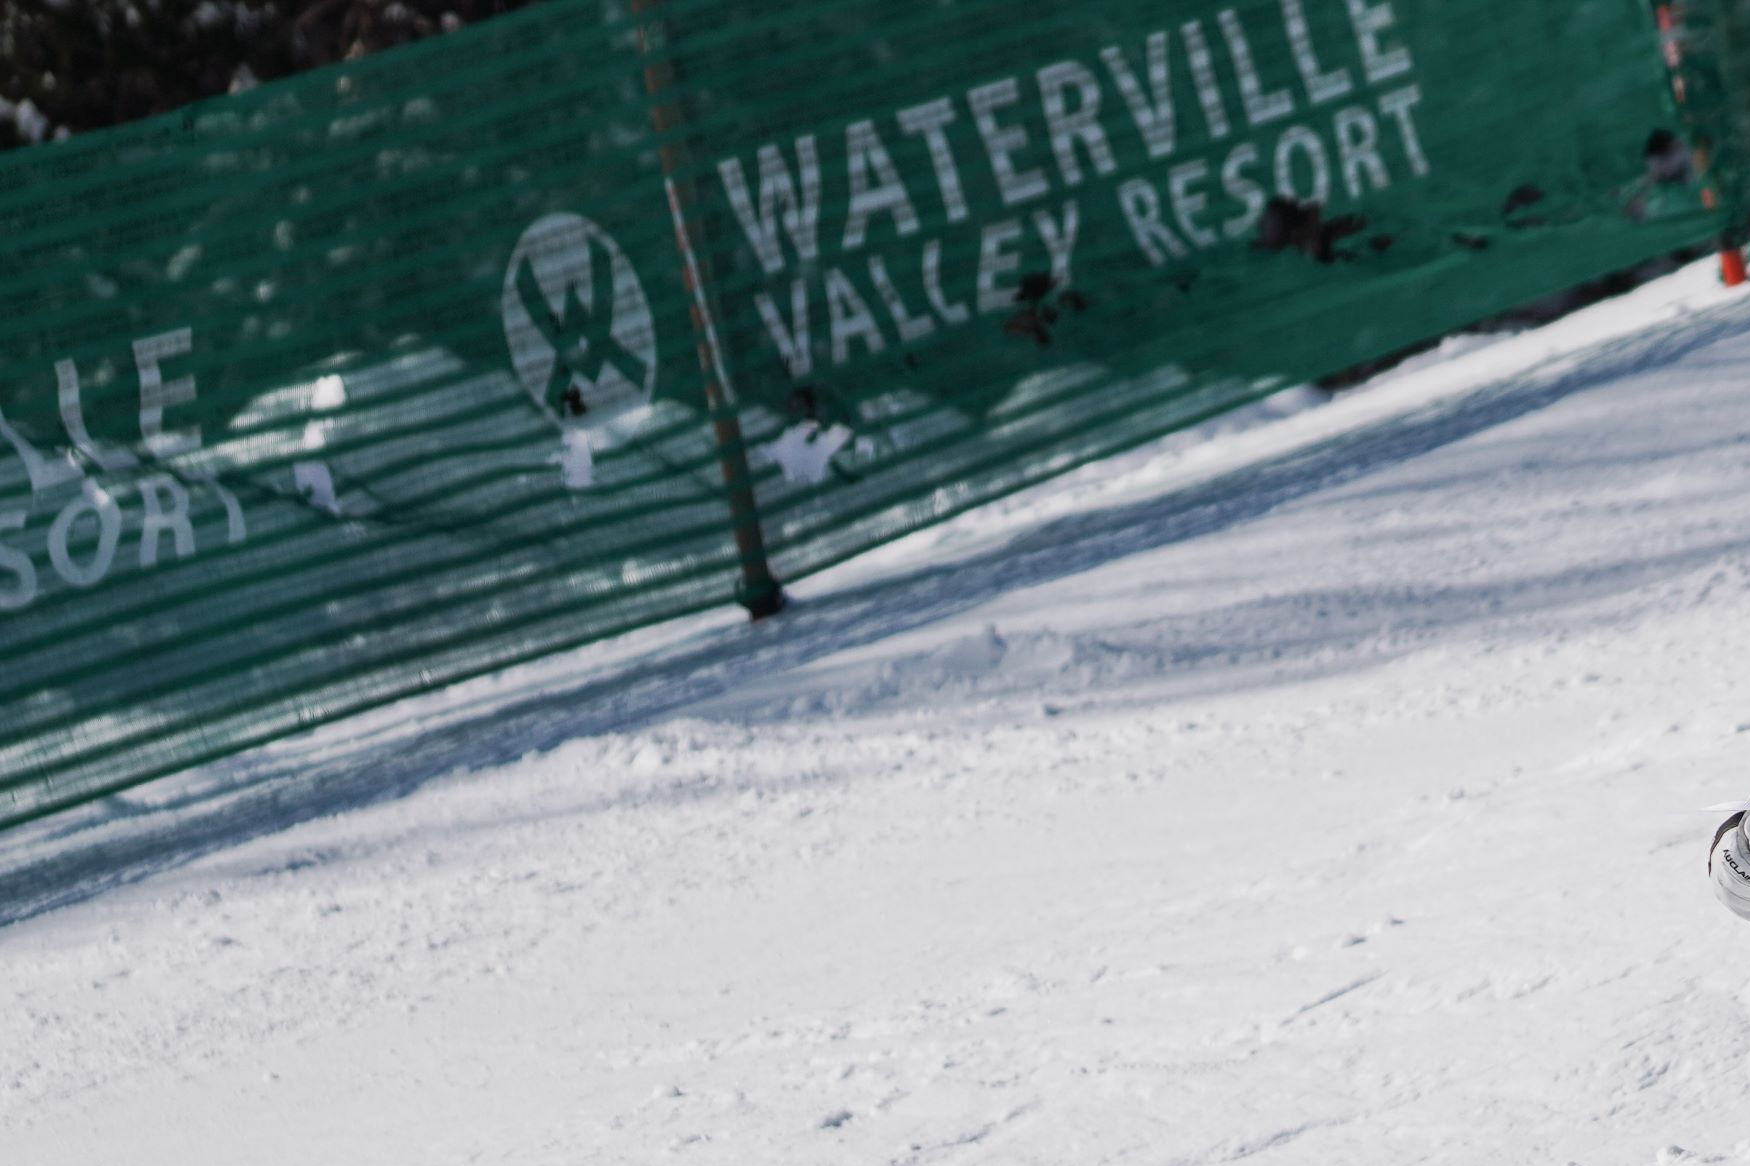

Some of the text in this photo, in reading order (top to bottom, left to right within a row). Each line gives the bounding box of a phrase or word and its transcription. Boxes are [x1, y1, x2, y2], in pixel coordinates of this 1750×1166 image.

[717, 0, 1412, 274] WATERVILLE
[754, 84, 1430, 377] VALLEY RESORT
